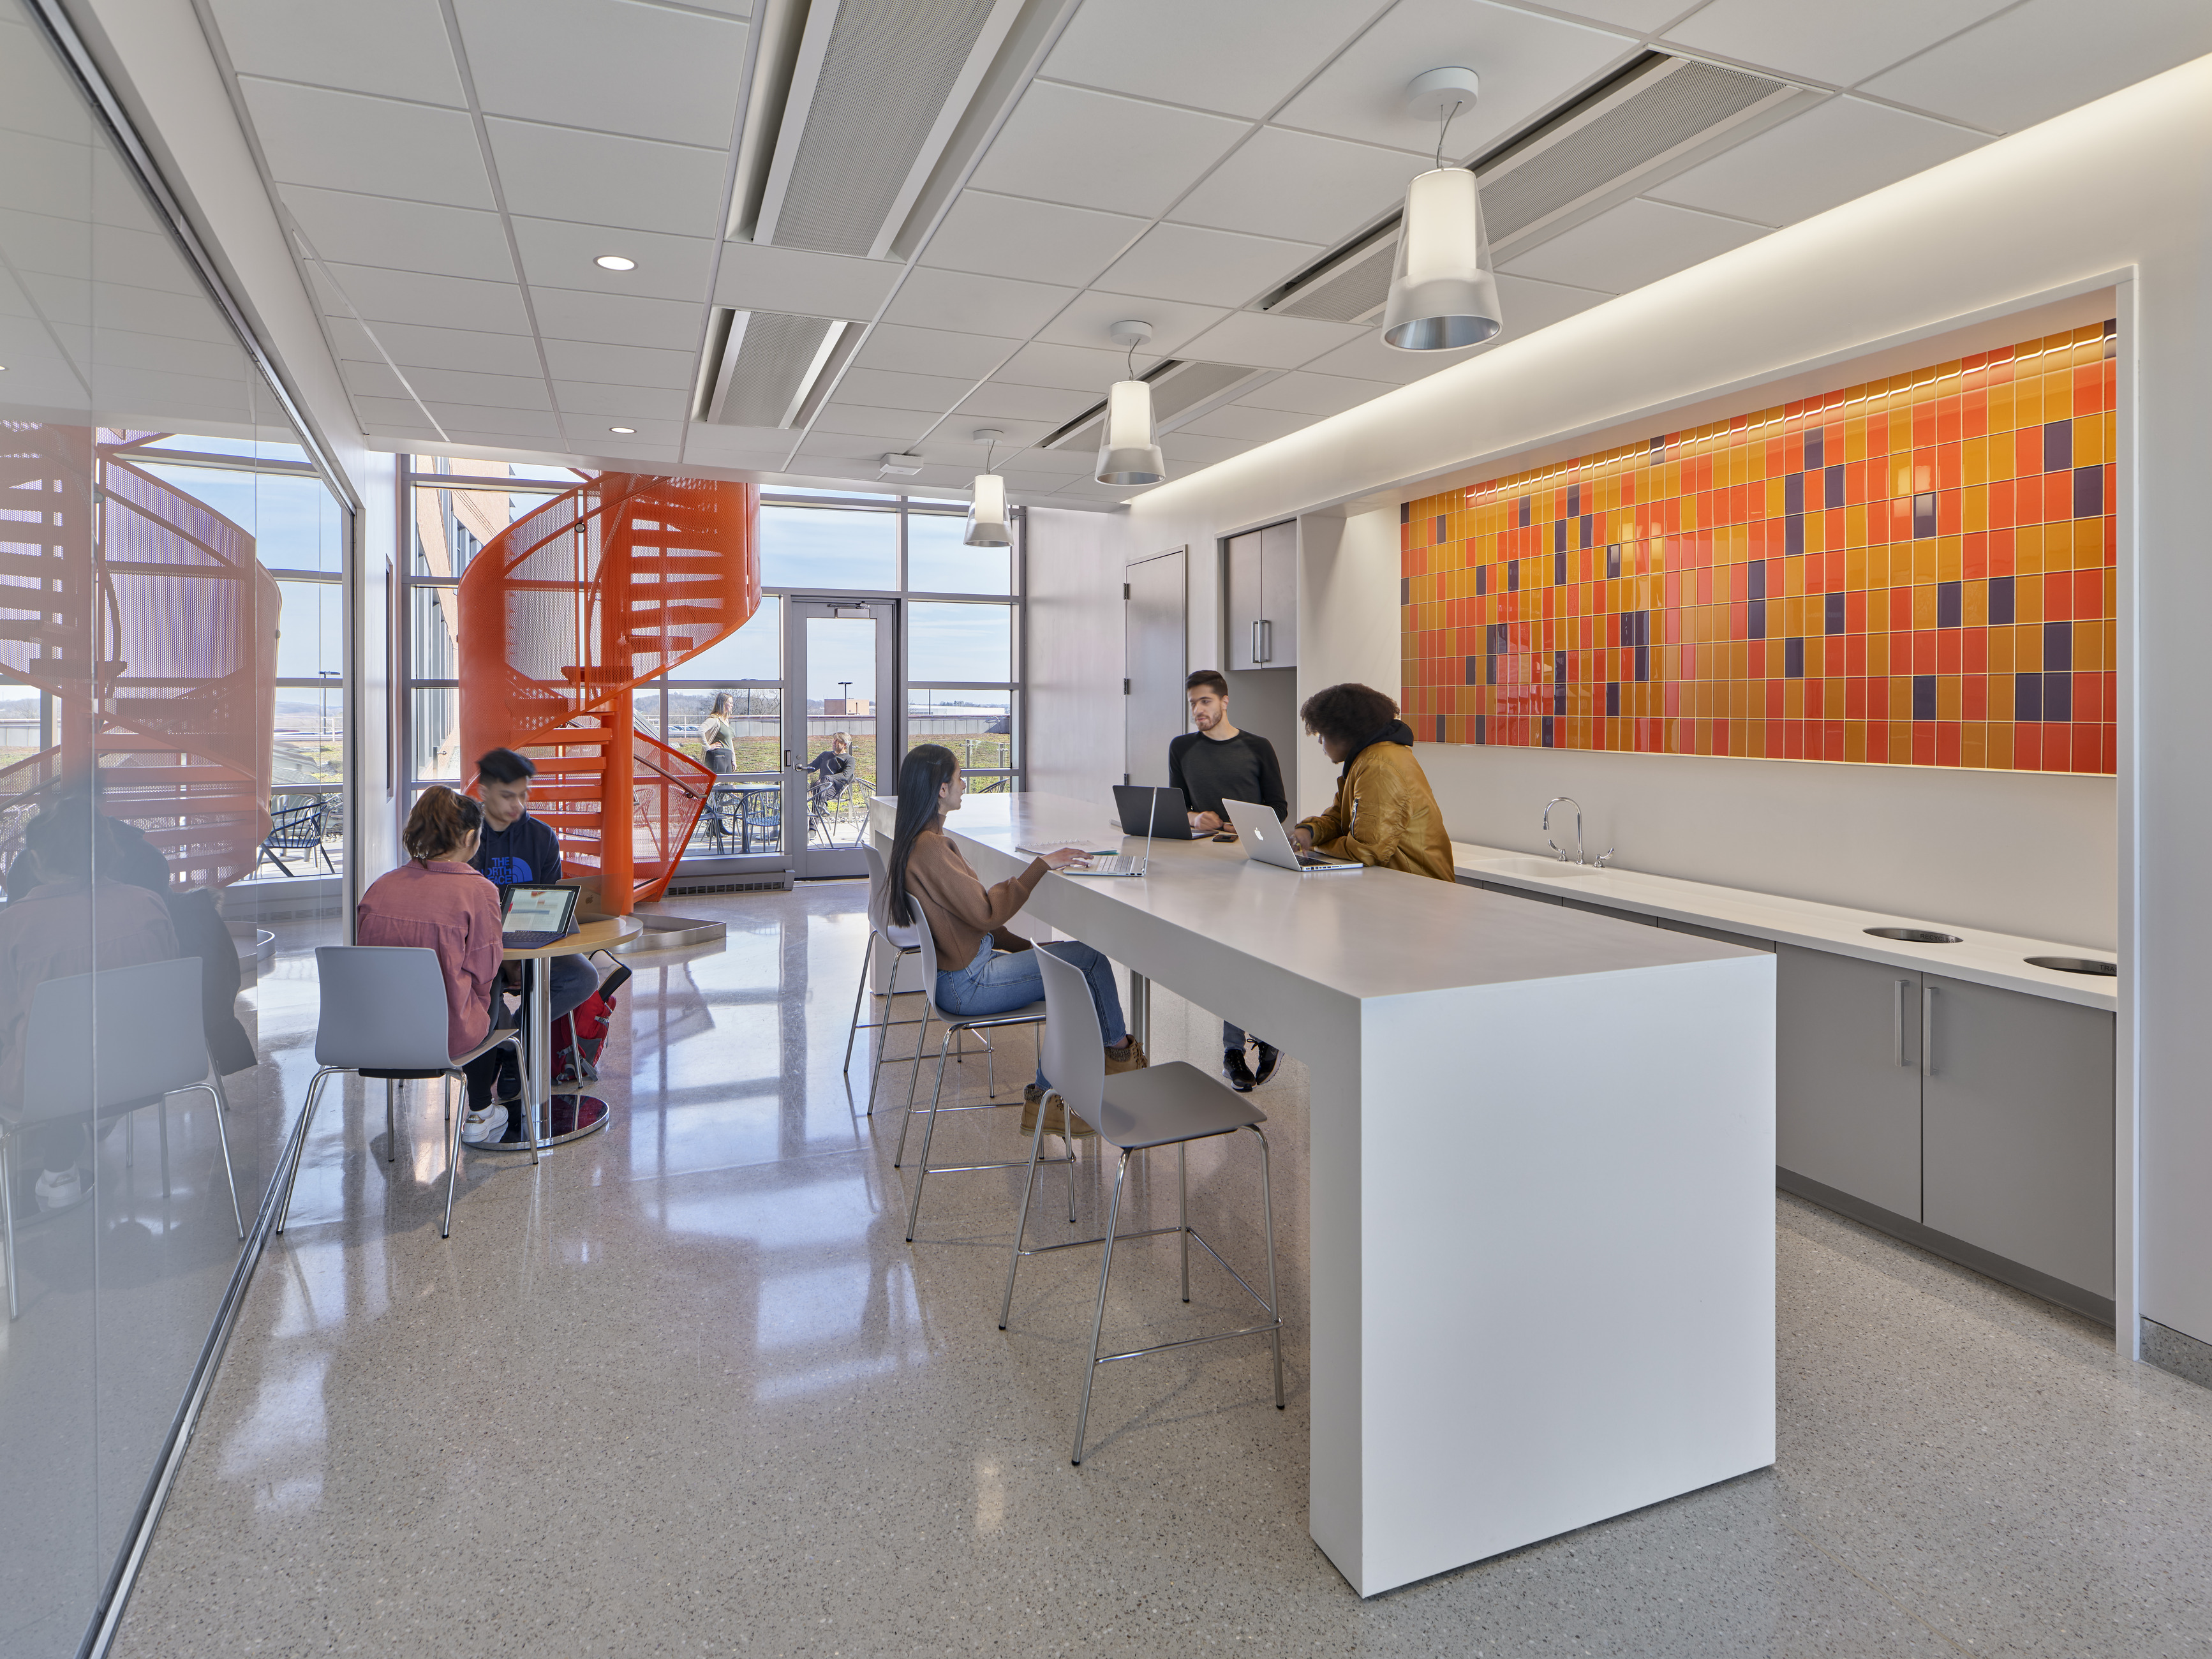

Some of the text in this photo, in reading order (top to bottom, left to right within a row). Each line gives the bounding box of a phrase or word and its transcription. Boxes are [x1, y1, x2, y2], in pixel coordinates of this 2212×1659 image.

[491, 857, 510, 867] THE
[1920, 934, 1954, 943] RECYCLING
[2099, 964, 2117, 973] TRA
